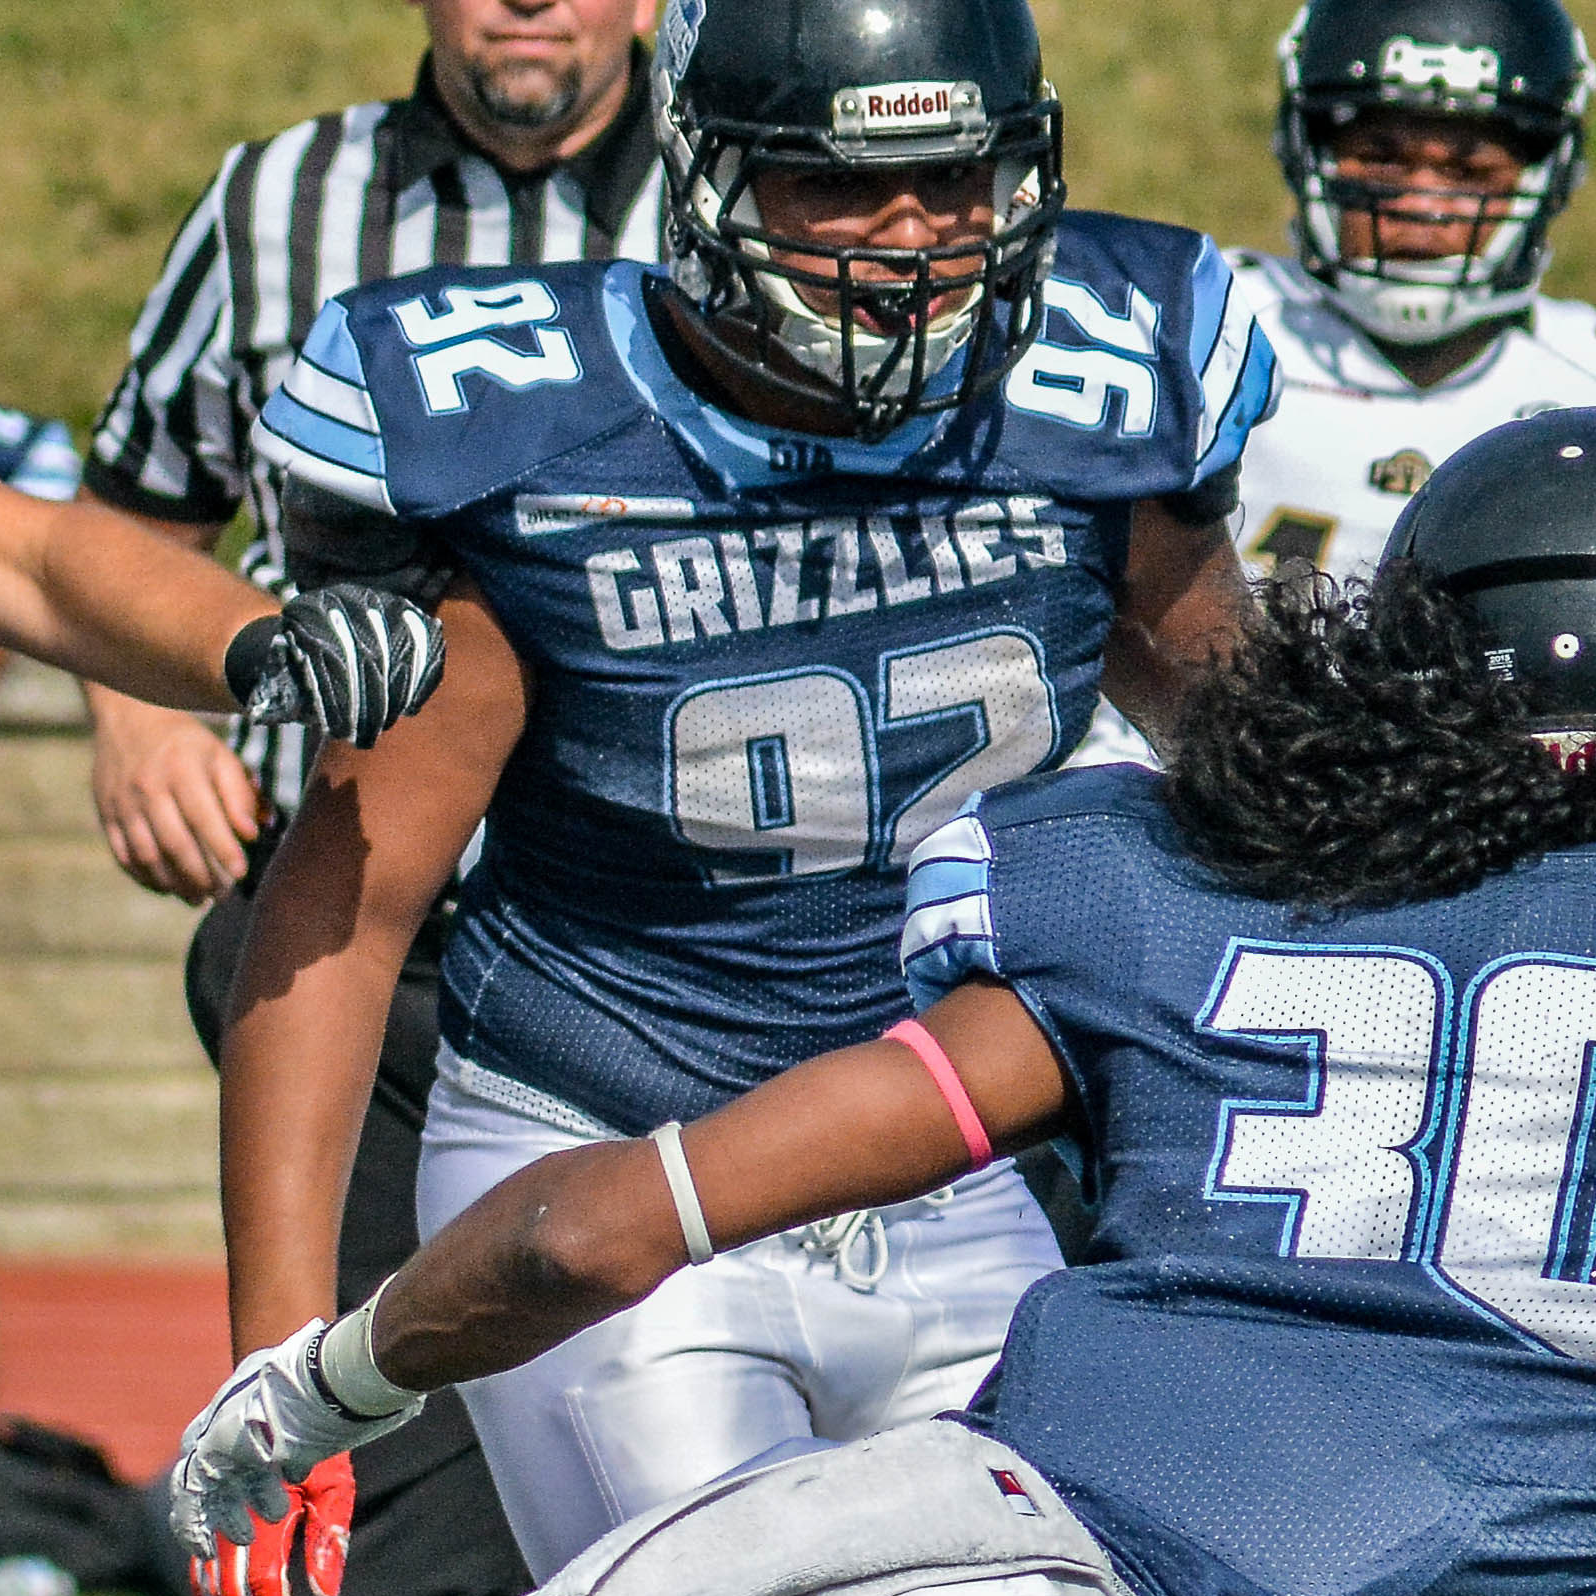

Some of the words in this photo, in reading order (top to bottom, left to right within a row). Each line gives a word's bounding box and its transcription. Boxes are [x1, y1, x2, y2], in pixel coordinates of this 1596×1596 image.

[868, 89, 950, 118] Riddell
[388, 278, 585, 417] 92
[1000, 273, 1162, 439] 92
[586, 494, 1067, 652] GRIZZLIES
[662, 625, 1062, 890] 92
